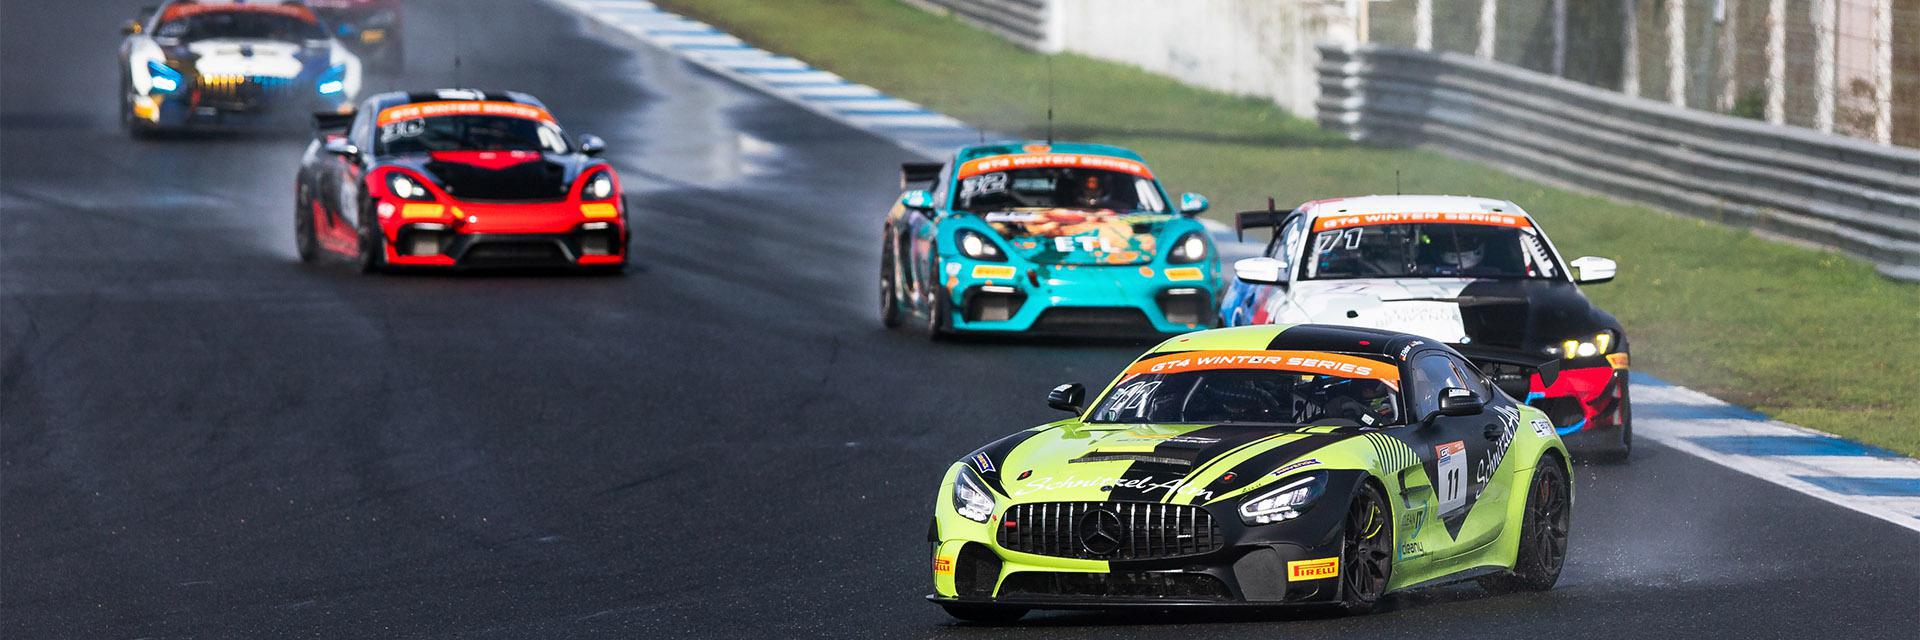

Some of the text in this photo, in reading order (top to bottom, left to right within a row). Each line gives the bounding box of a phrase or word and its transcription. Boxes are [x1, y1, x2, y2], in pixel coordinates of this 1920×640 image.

[1323, 211, 1516, 229] GT4 WINTER SERIES
[1318, 227, 1363, 251] 71
[1151, 354, 1373, 377] GT4 WINTER SERIES
[1447, 467, 1460, 501] 11
[1293, 562, 1336, 577] PIRELLI
